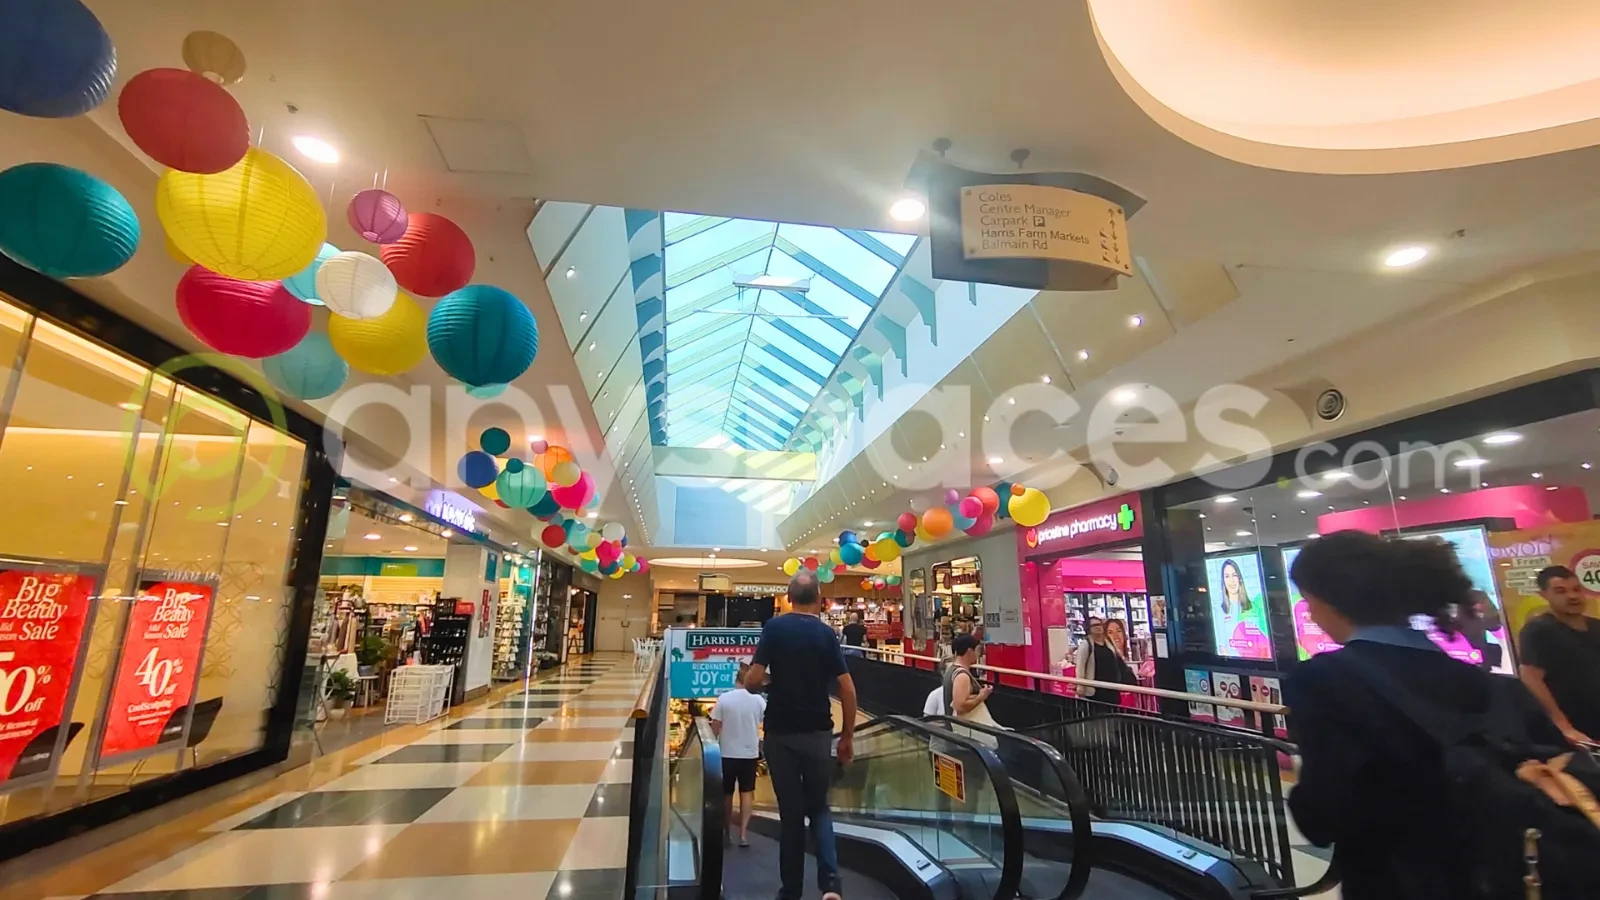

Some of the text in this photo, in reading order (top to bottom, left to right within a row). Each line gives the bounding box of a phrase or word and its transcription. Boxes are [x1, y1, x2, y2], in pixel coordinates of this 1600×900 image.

[979, 191, 1012, 203] Coles
[979, 203, 1072, 219] Centre Manager
[980, 215, 1029, 228] Carpark
[981, 228, 1090, 245] Harris Farm Markets
[982, 239, 1048, 250] Balmain Rd
[1070, 513, 1118, 539] pharmacy
[15, 576, 62, 609] Big
[160, 588, 191, 612] Big
[0, 598, 68, 624] Beauty
[152, 605, 194, 627] Beauty
[18, 621, 60, 641] Sale
[163, 623, 189, 639] Sale
[691, 635, 760, 646] HARRIS FAR
[691, 670, 719, 686] JOY
[24, 697, 46, 713] off
